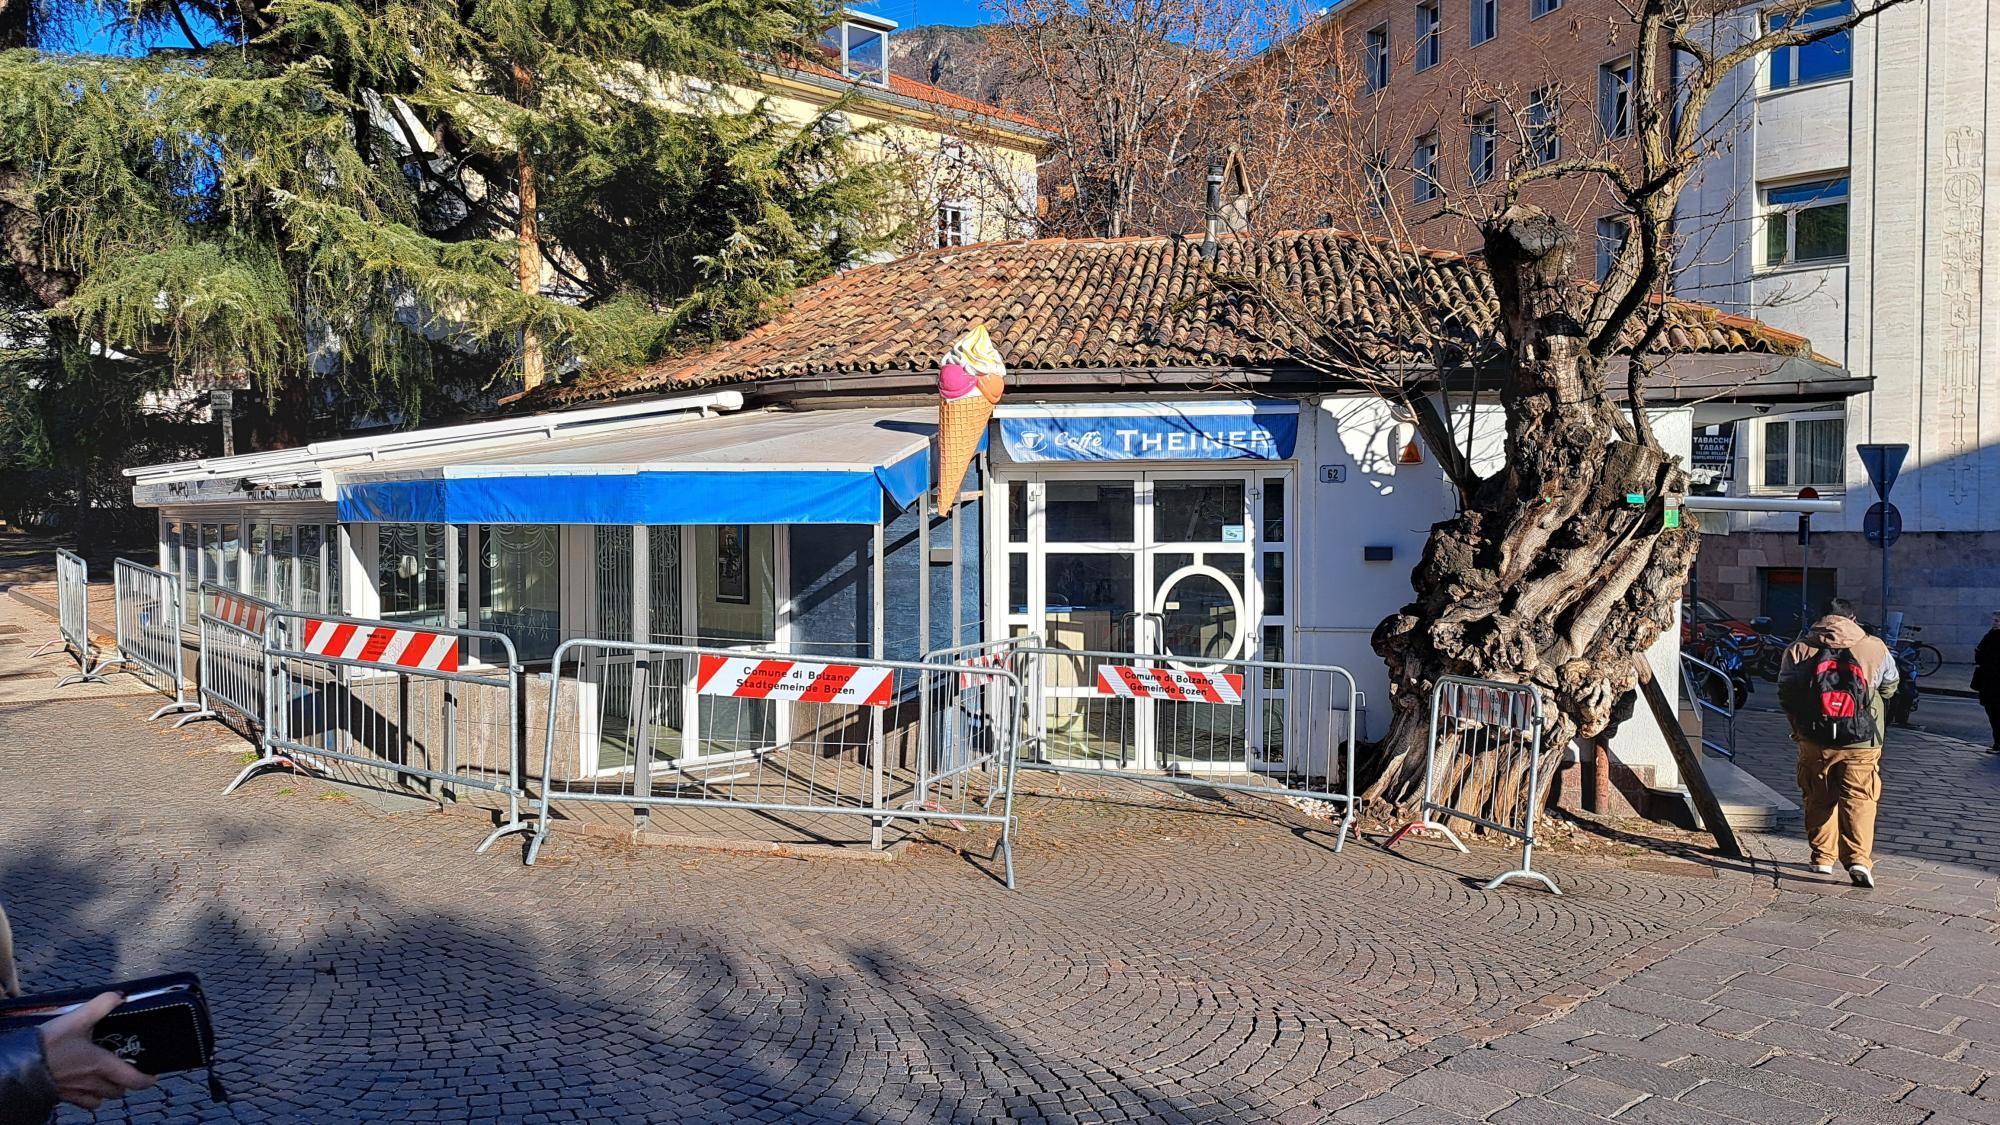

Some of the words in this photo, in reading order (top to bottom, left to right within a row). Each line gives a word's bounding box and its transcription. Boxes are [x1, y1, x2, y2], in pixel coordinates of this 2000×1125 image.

[1116, 429, 1272, 451] THEINER
[1693, 436, 1731, 444] TABACCH
[1327, 469, 1339, 479] 62
[743, 666, 788, 679] Comune
[792, 670, 803, 680] di
[808, 671, 850, 682] Bolzano
[1124, 671, 1162, 682] Comune
[1164, 674, 1173, 683] di
[1176, 675, 1214, 685] Bolzano
[736, 679, 818, 693] Stadtgemeinde
[824, 685, 855, 695] Bozen
[1130, 683, 1176, 694] Gemeinde
[1179, 687, 1207, 696] Bozen
